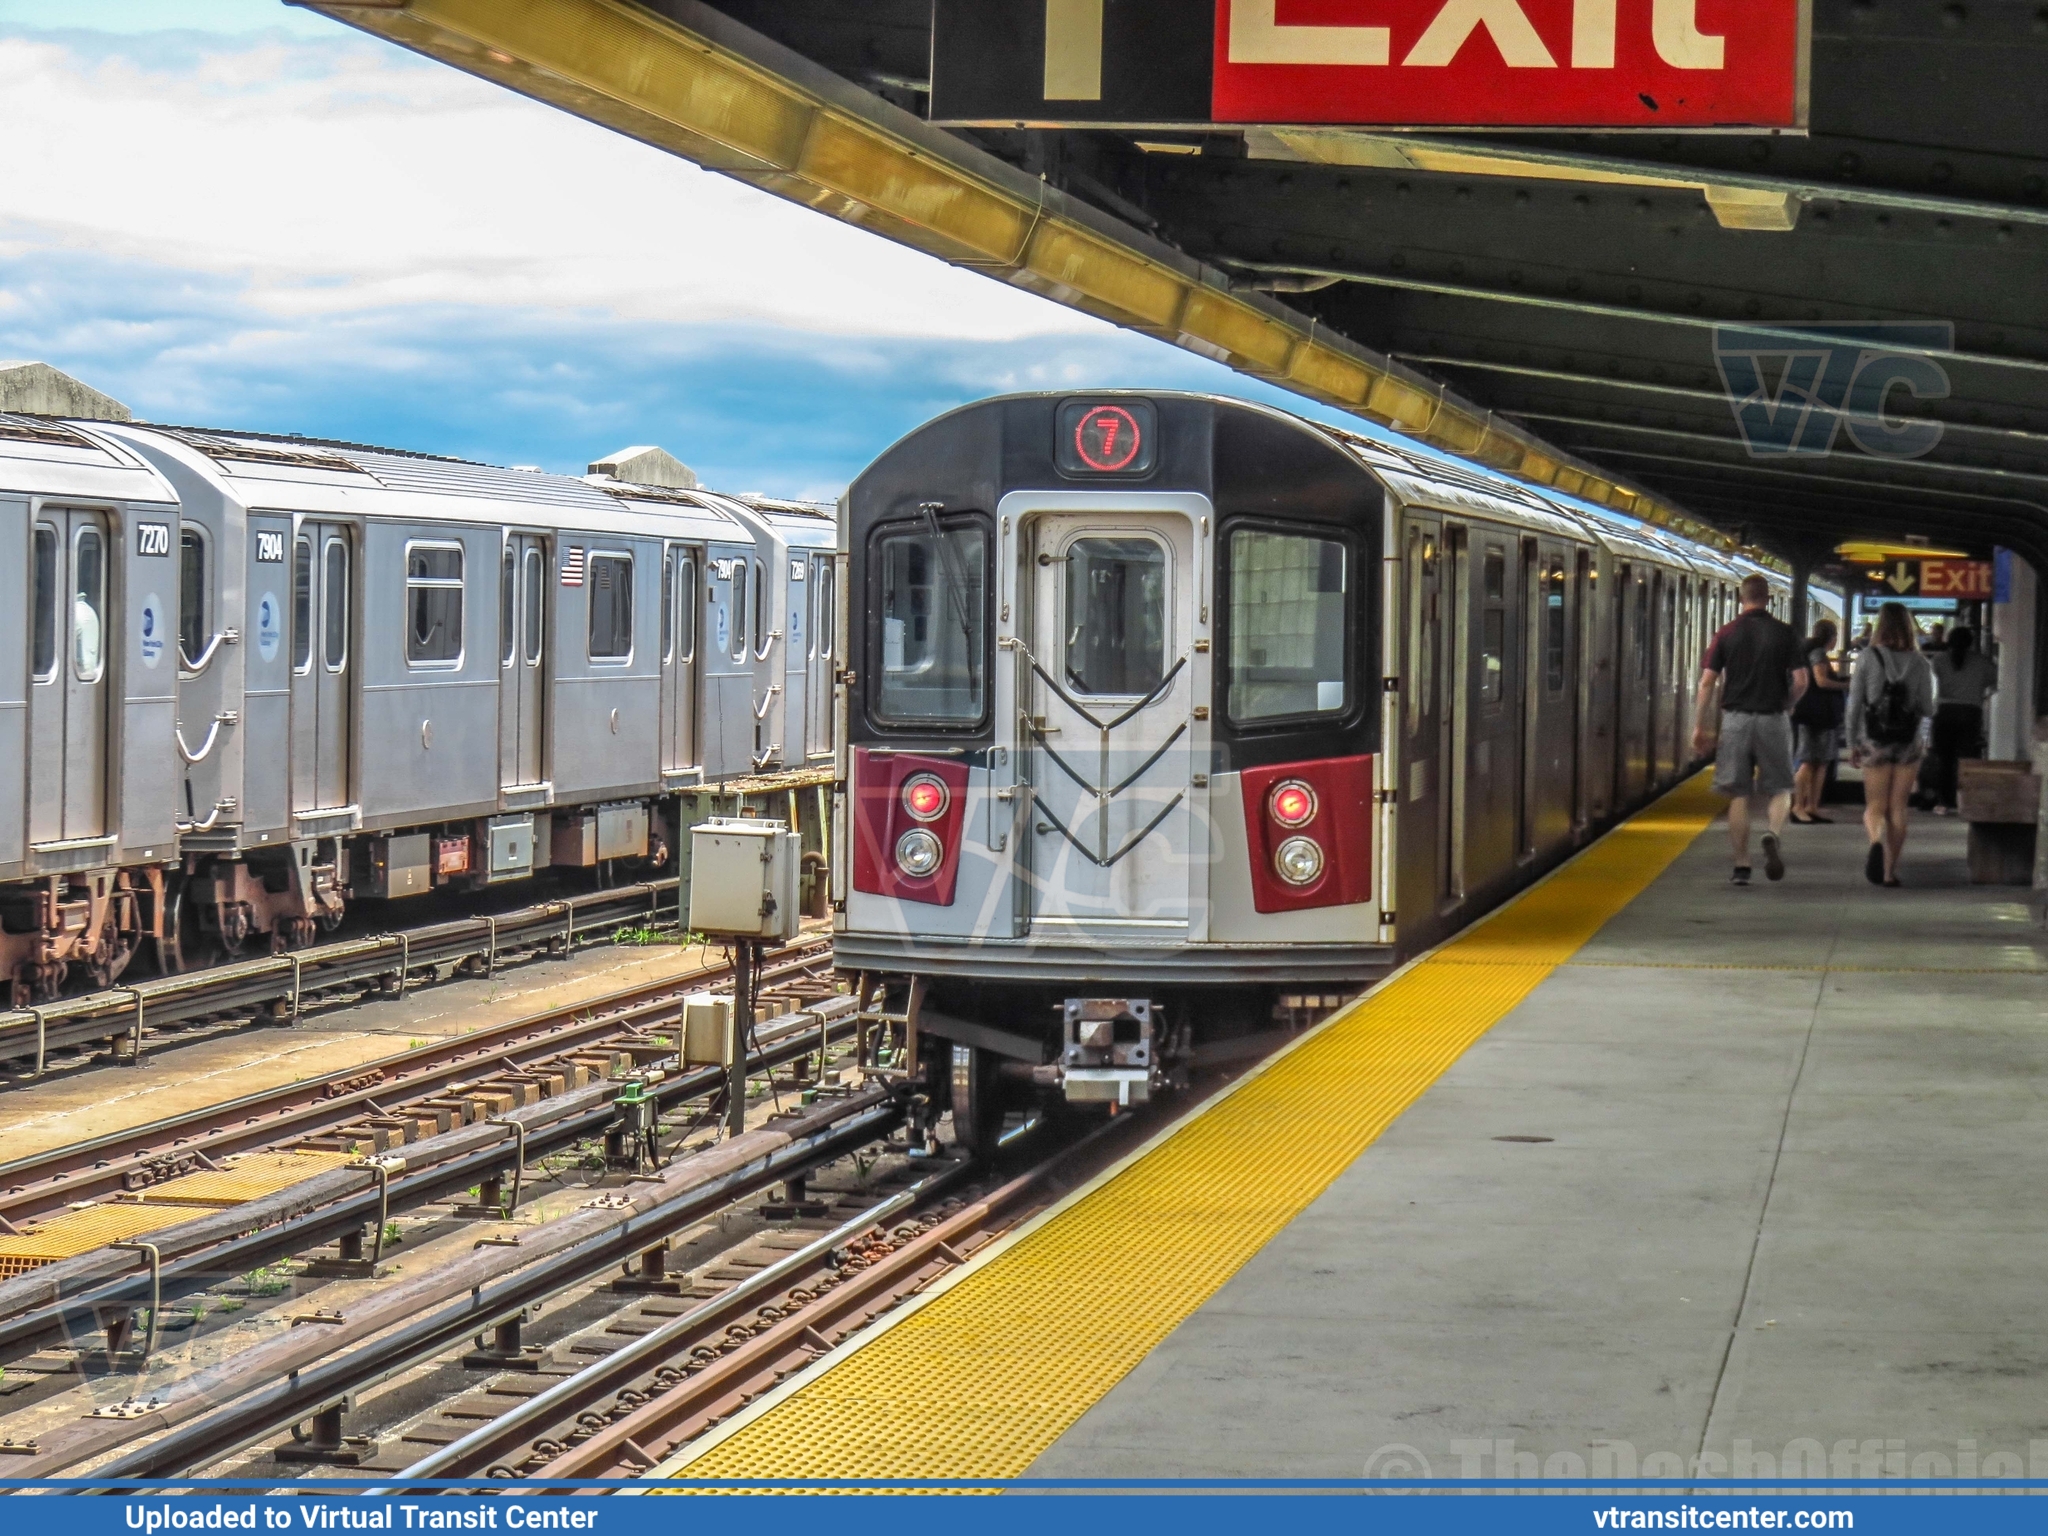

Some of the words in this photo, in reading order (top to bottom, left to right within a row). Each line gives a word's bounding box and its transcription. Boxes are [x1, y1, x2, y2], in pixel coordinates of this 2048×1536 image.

[1097, 419, 1118, 455] 7
[138, 524, 169, 554] 7270
[257, 532, 283, 560] 7904
[1919, 560, 1993, 593] Exit
